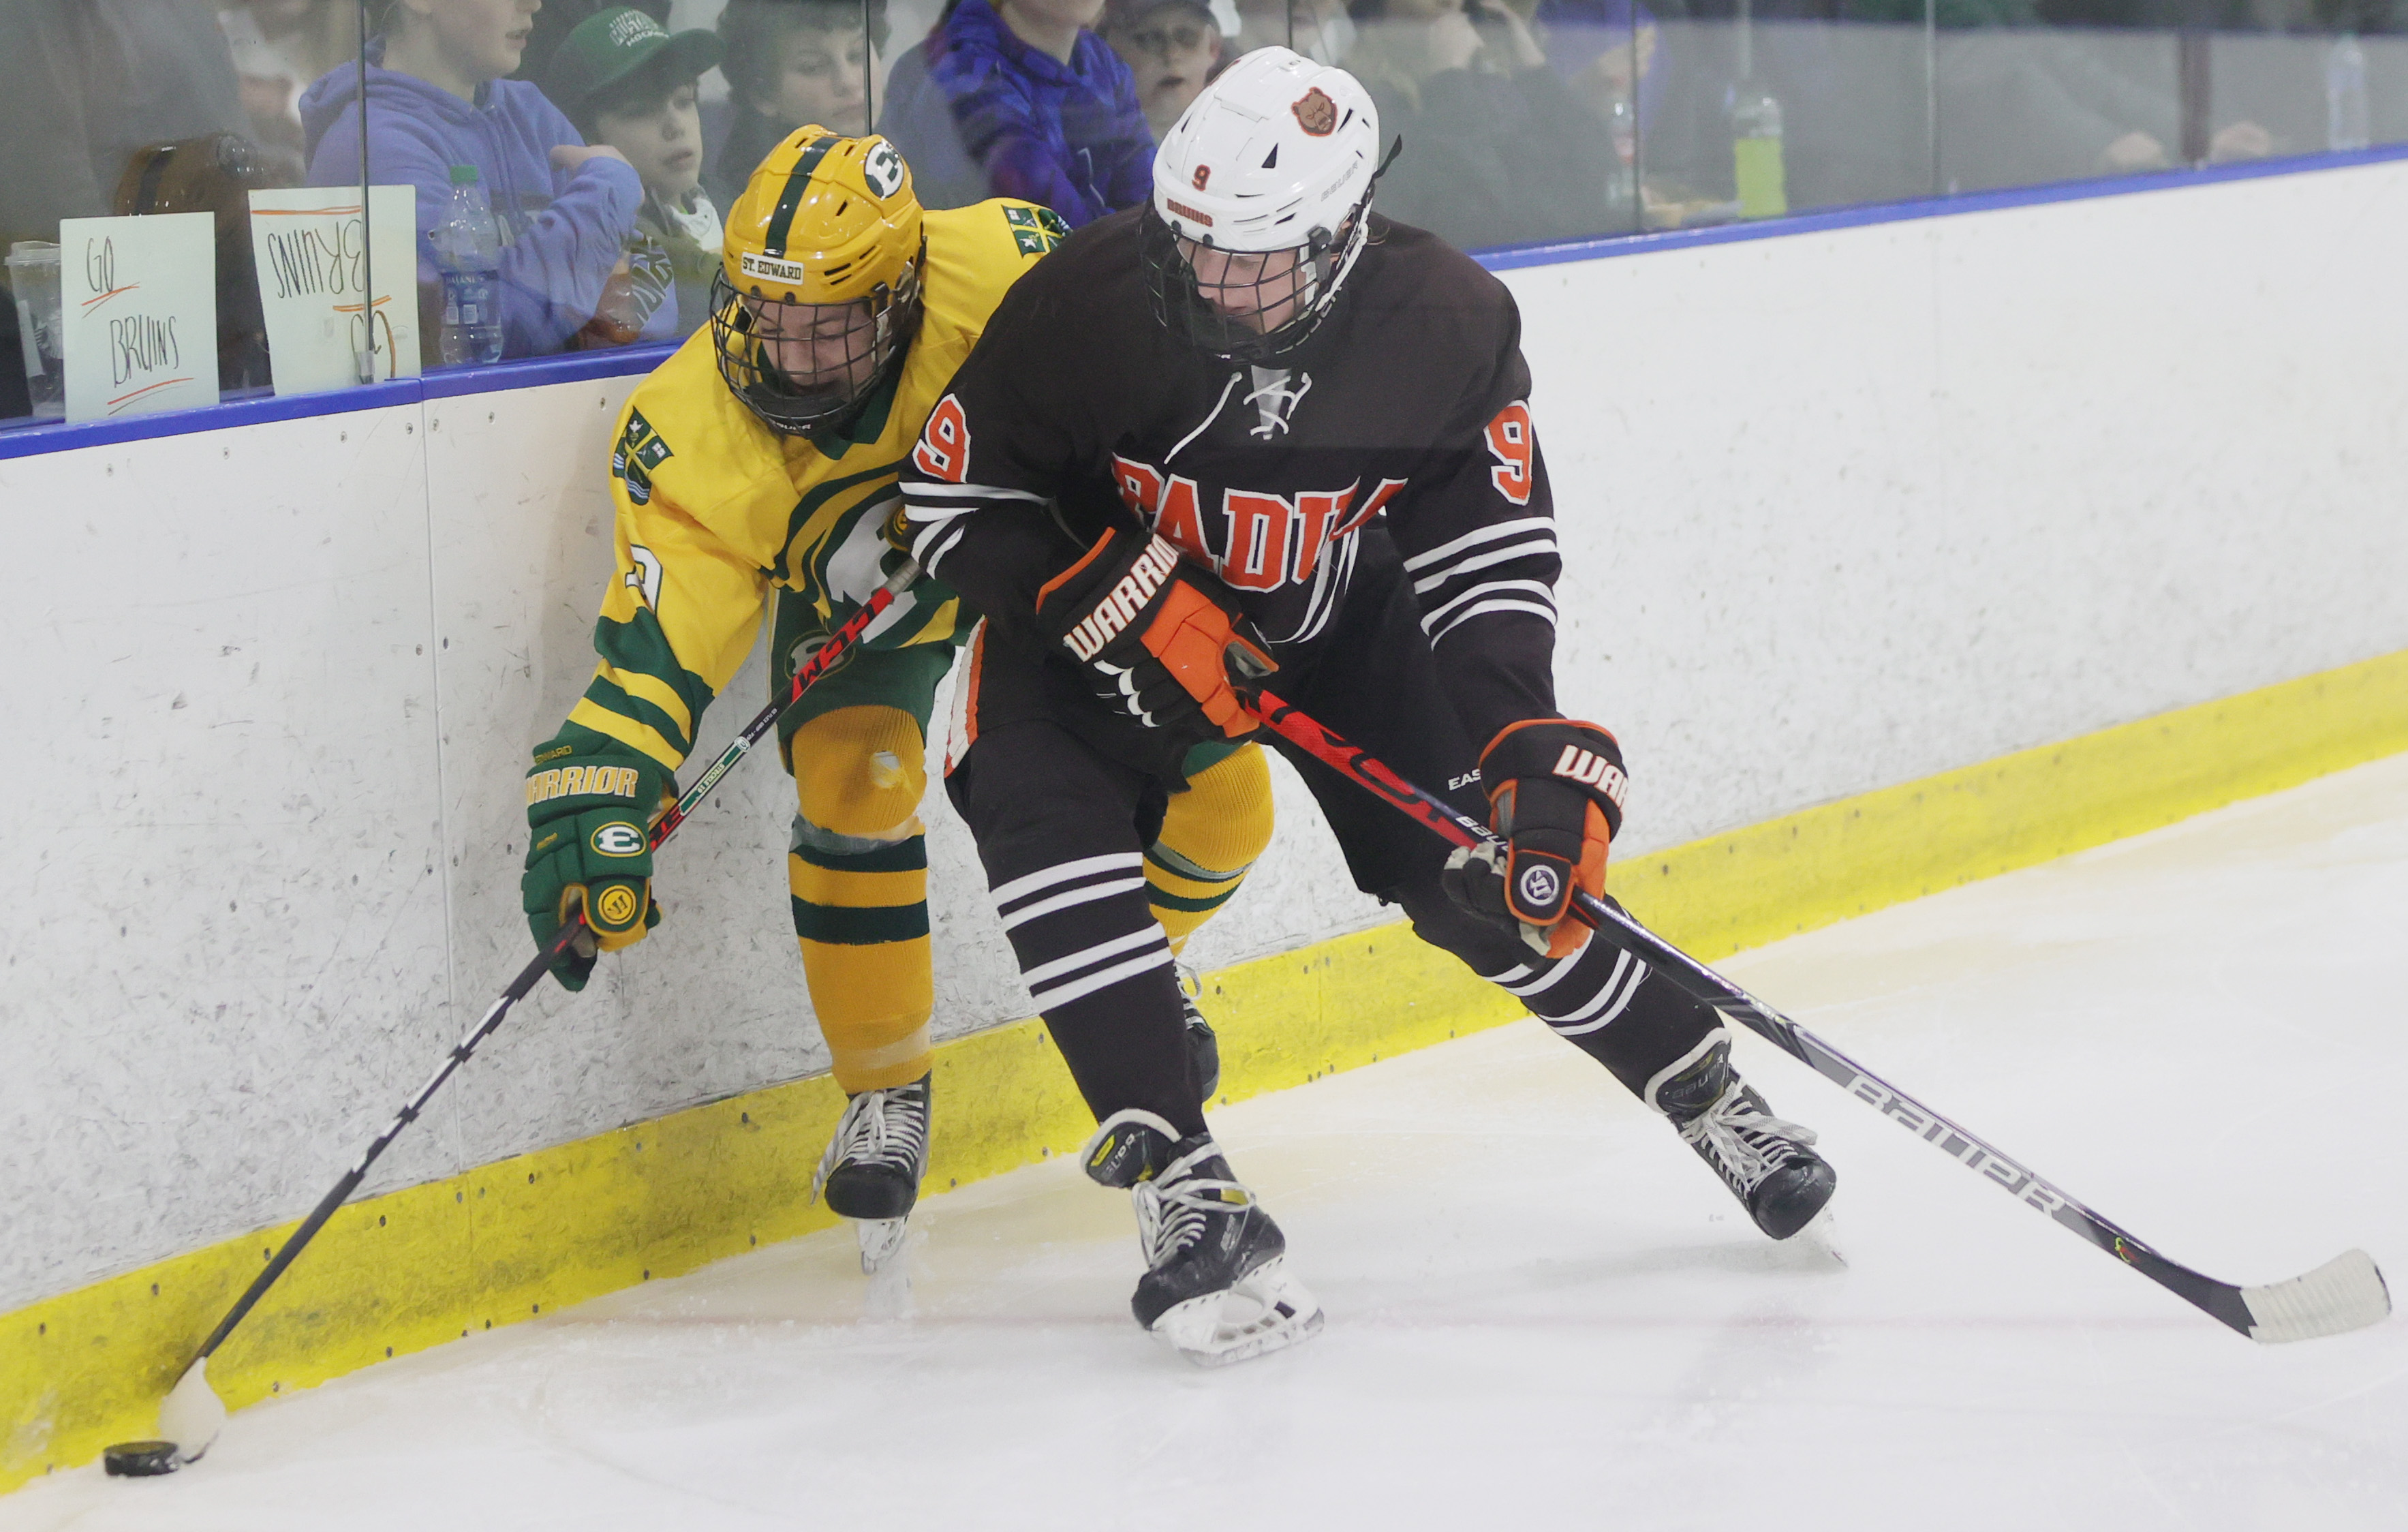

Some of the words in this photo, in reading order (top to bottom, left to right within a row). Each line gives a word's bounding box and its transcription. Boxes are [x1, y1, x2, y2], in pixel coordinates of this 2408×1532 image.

[1192, 164, 1211, 192] 9
[1167, 198, 1214, 228] BRUINS
[87, 235, 114, 293] GO
[743, 257, 756, 272] ST.
[758, 260, 802, 280] EDWARD
[110, 314, 179, 388] BRUINS
[912, 393, 972, 484] 9
[1483, 400, 1532, 506] 9
[525, 765, 639, 806] ARRIOR
